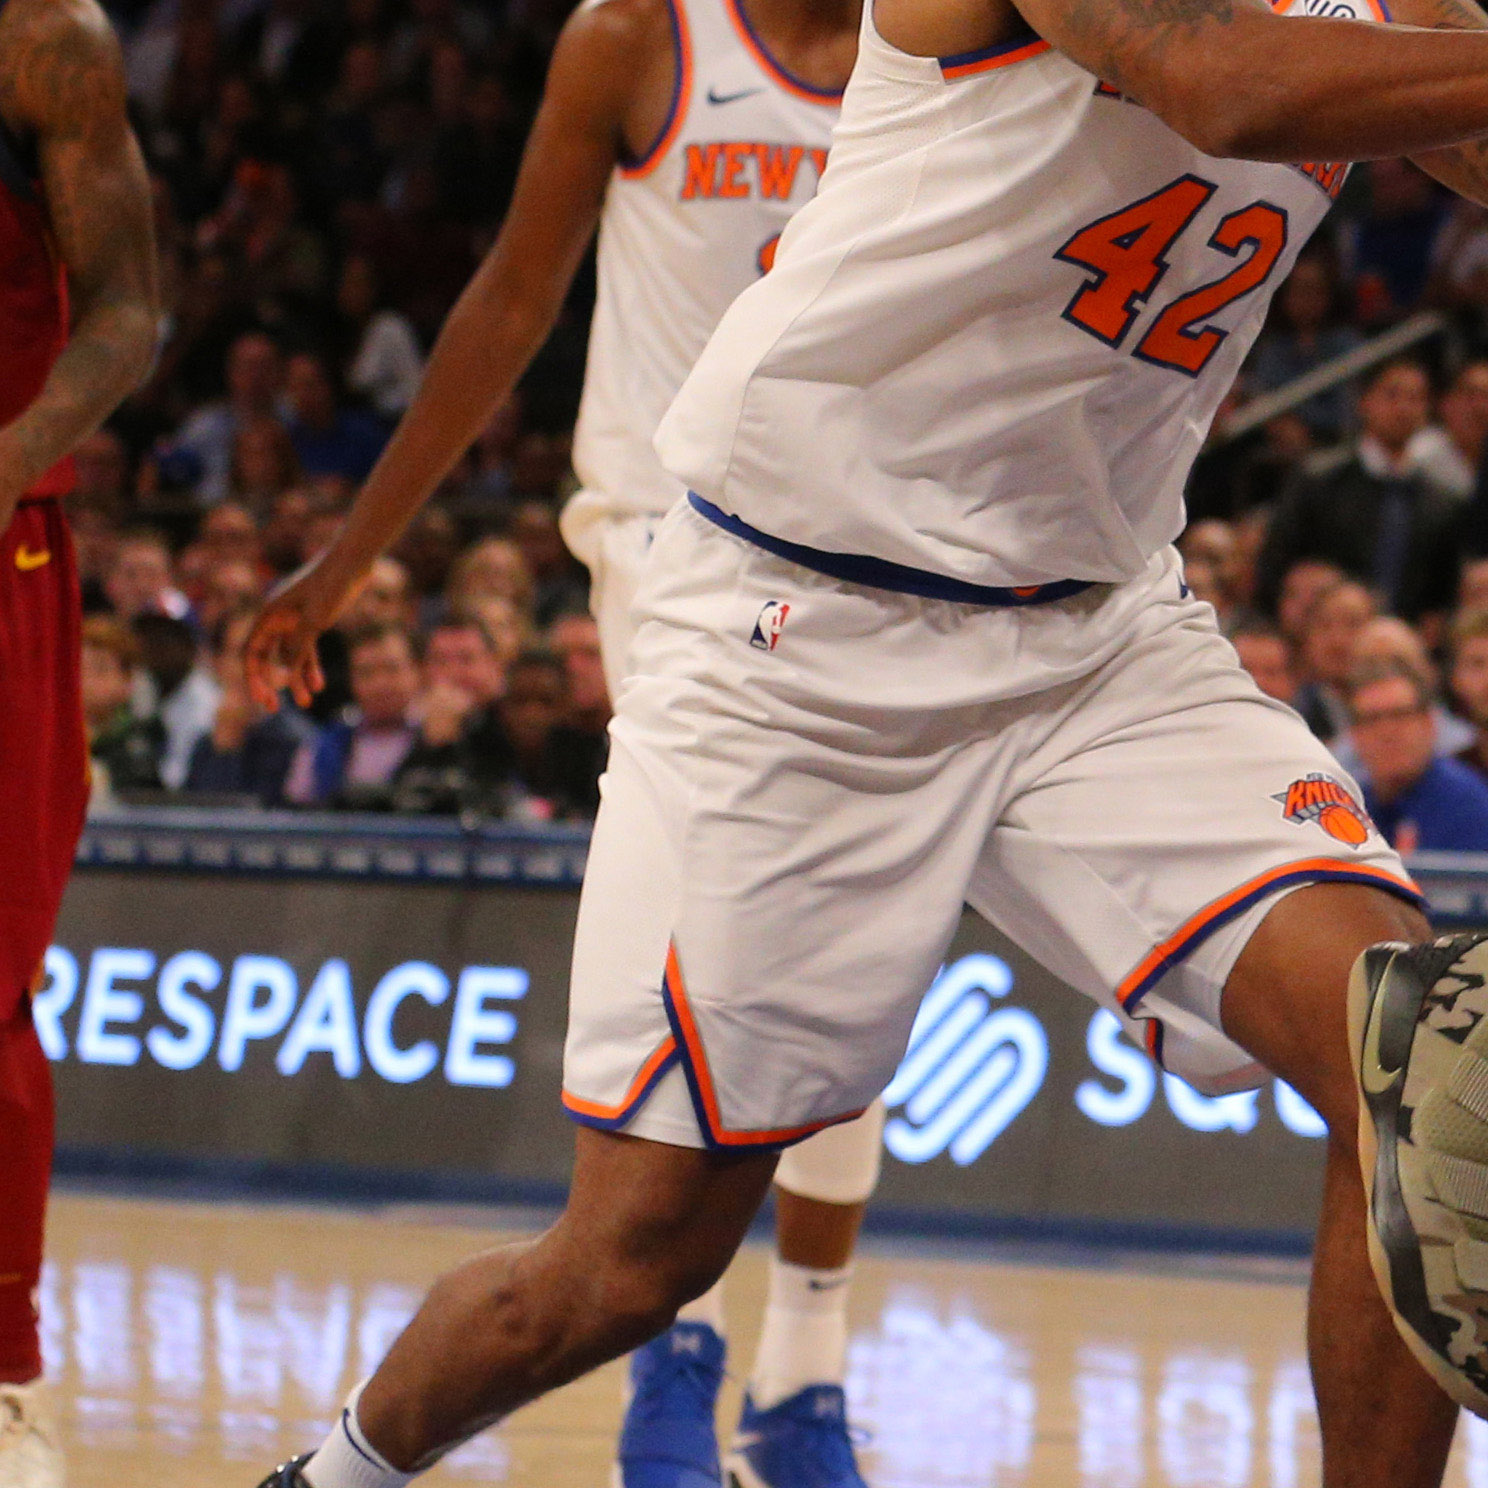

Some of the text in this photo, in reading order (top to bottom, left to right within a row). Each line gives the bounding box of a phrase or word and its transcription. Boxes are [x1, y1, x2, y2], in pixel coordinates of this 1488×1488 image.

[679, 139, 808, 203] NEW
[1055, 173, 1289, 379] 42
[31, 944, 530, 1089] RESPACE
